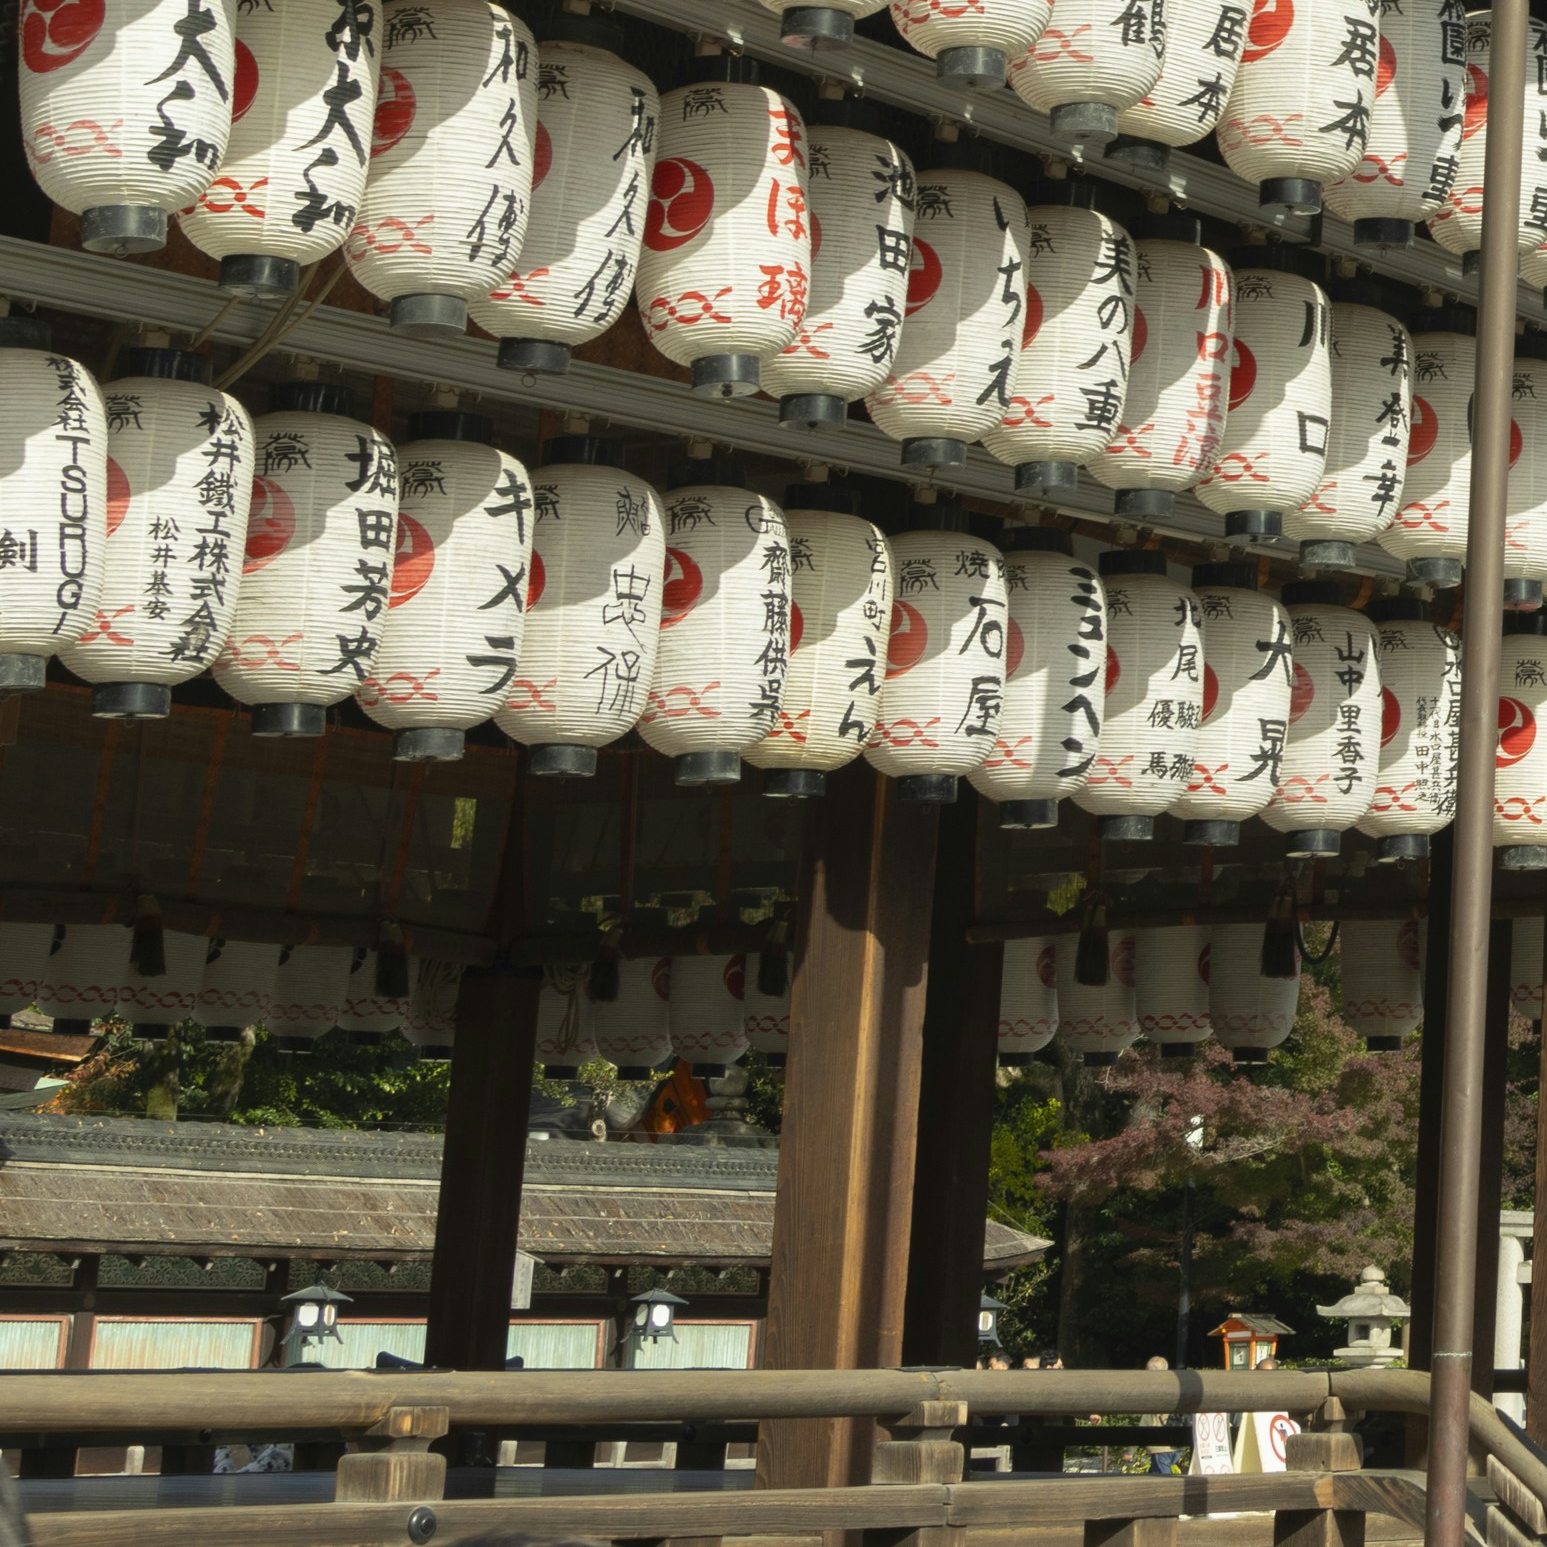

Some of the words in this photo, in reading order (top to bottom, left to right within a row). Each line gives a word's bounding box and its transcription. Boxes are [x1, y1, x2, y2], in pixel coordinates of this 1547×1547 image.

[855, 155, 914, 363] 池田家
[1073, 229, 1133, 434] 美の八重
[46, 356, 90, 433] 株式会社
[1297, 300, 1334, 454] 川口
[52, 435, 90, 635] TSURUGI
[143, 515, 182, 620] 松井基安
[465, 468, 533, 694] キメラ
[1331, 631, 1364, 795] 山中里香子
